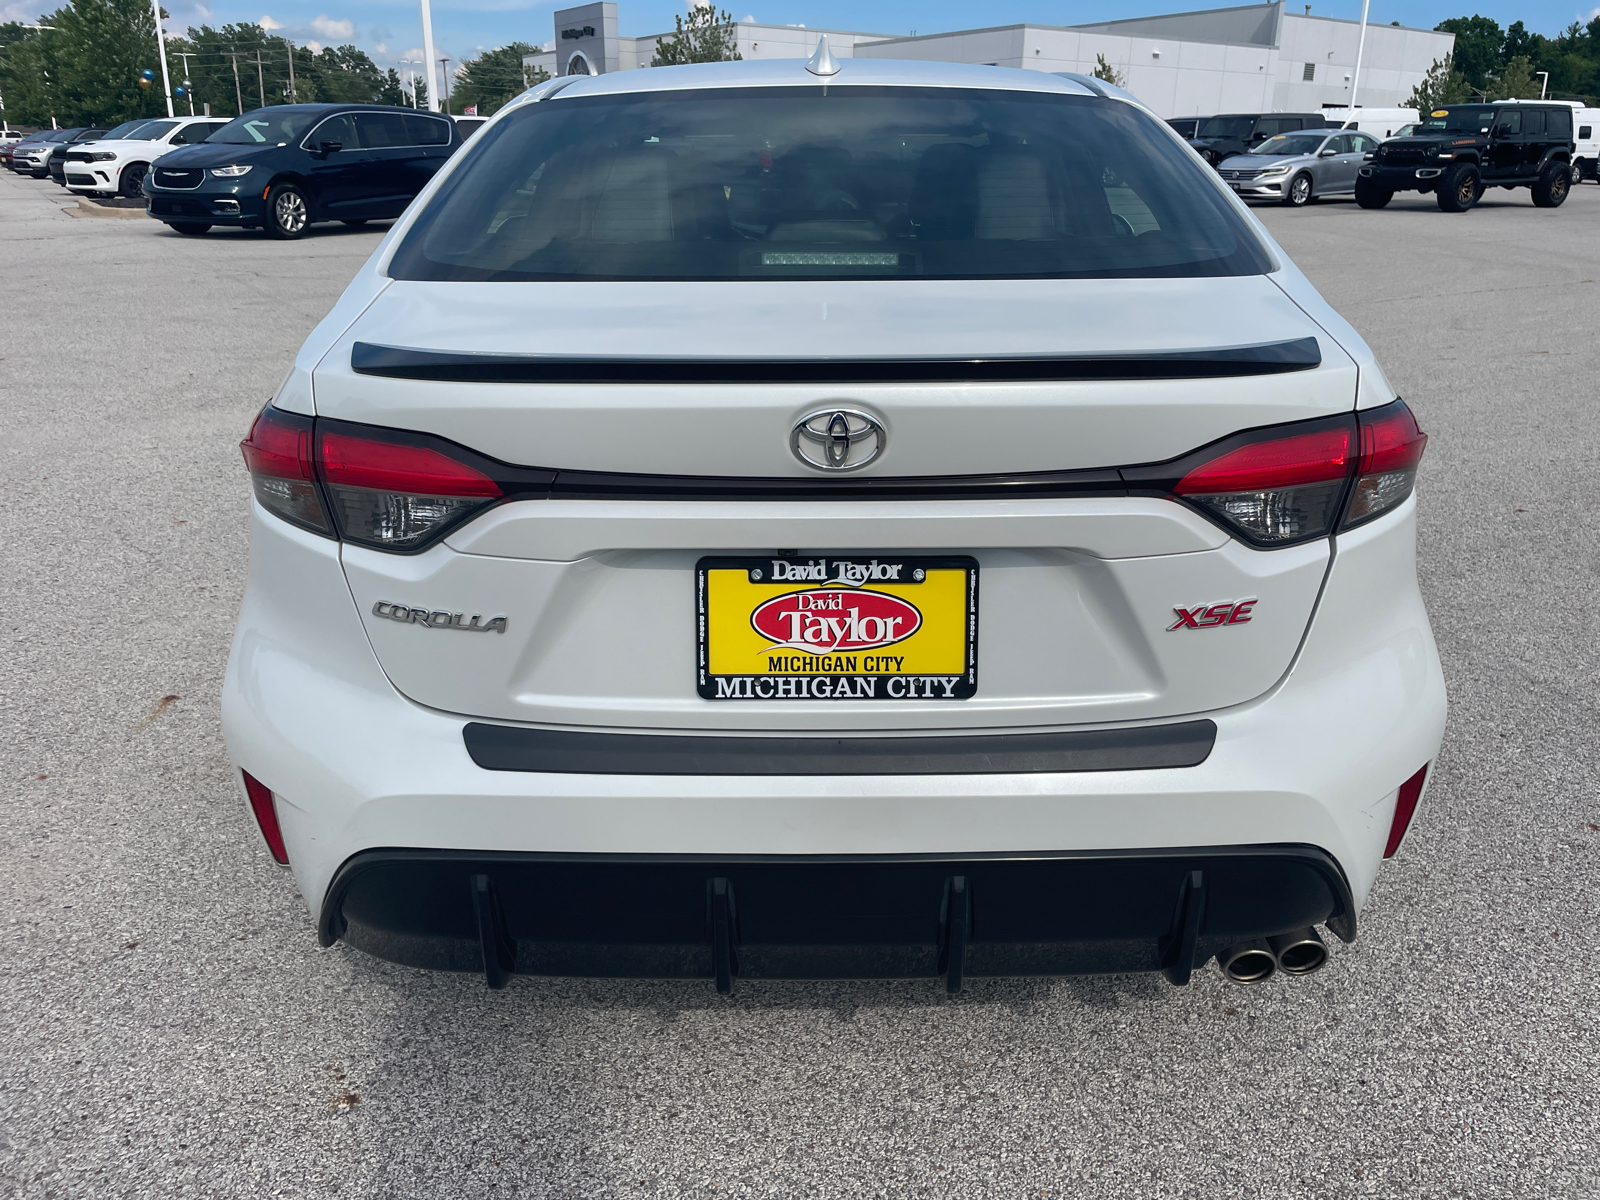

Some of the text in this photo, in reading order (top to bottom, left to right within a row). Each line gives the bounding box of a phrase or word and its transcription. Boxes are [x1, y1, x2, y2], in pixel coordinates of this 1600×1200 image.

[772, 560, 902, 587] David Taylor
[797, 594, 843, 610] David
[1165, 596, 1258, 631] XSE
[372, 599, 508, 634] COROLLA
[763, 607, 902, 655] Taylor
[768, 656, 904, 672] MICHIGAN CITY
[715, 676, 959, 698] MICHIGAN CITY
